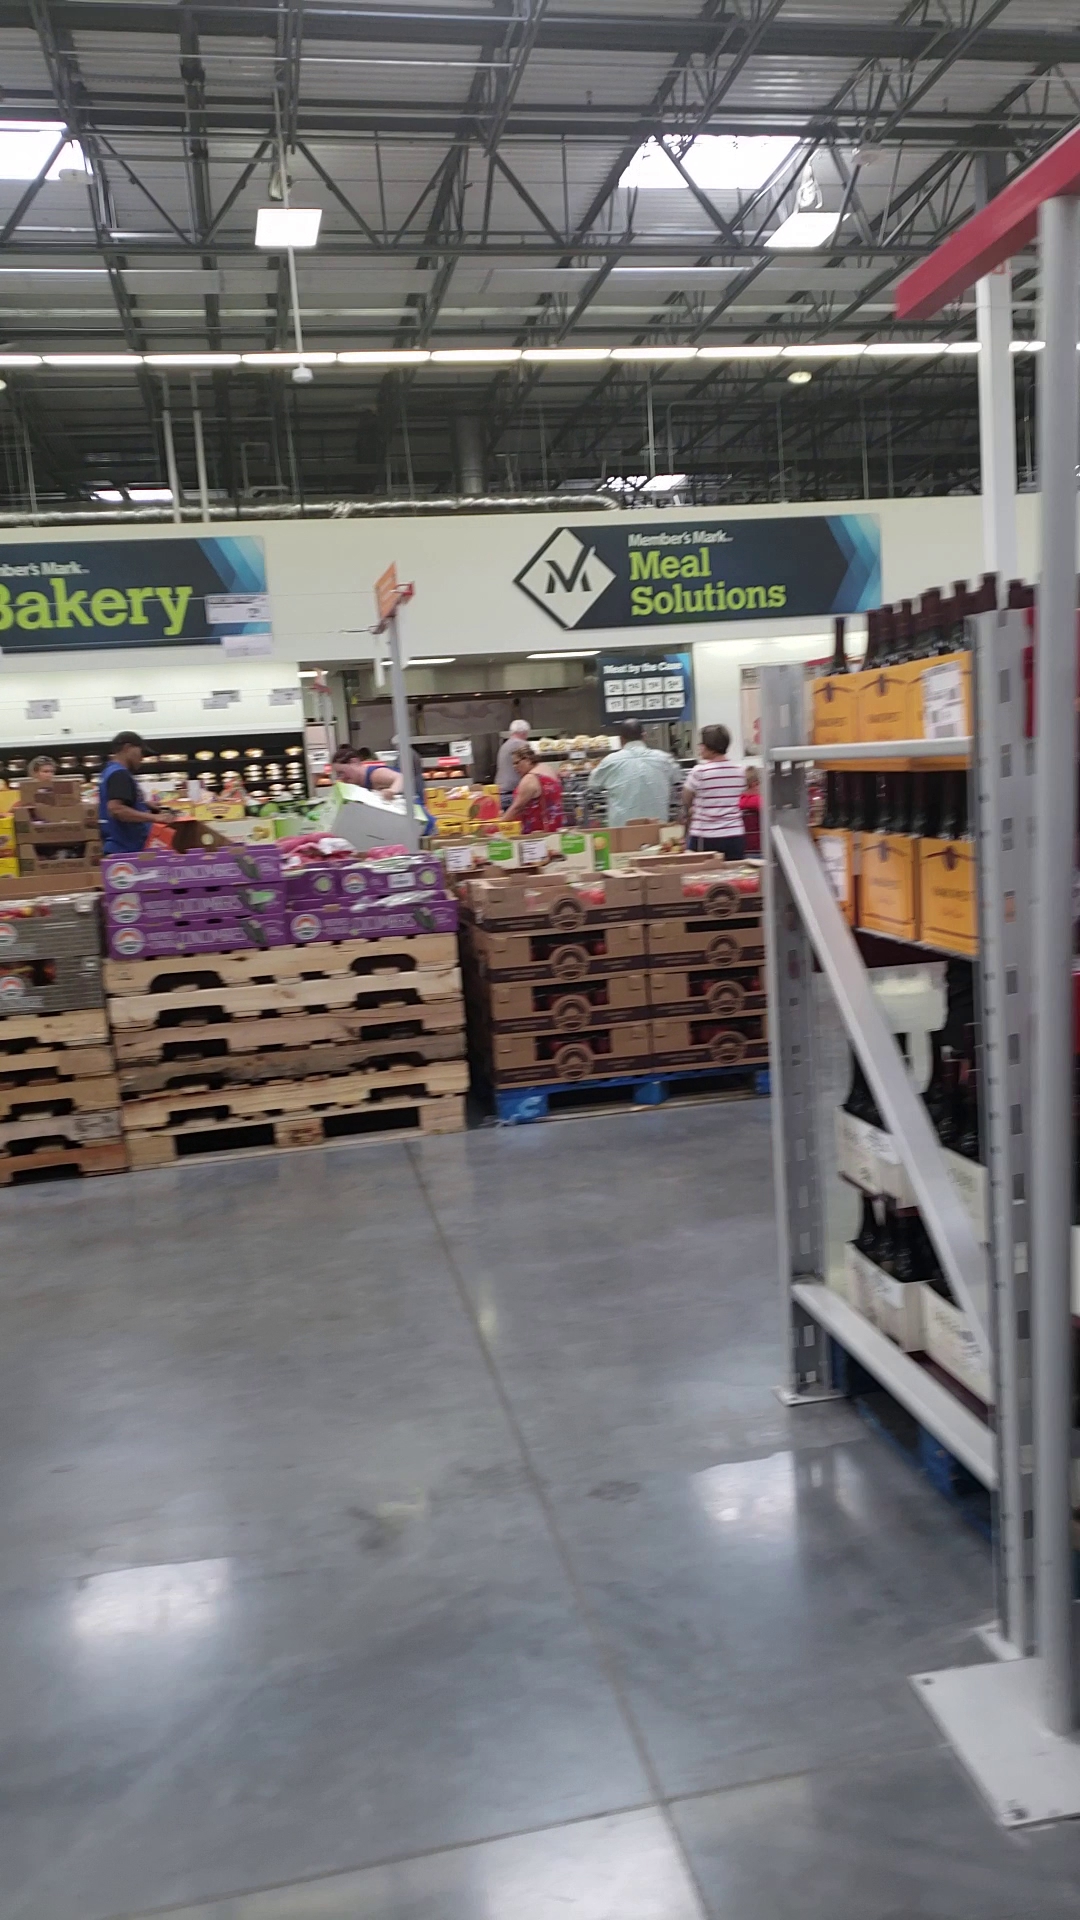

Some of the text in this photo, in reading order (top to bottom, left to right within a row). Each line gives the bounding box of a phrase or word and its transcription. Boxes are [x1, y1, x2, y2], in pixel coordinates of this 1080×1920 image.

[627, 531, 691, 547] Member's
[629, 547, 712, 581] Meal
[631, 581, 788, 616] Solutions
